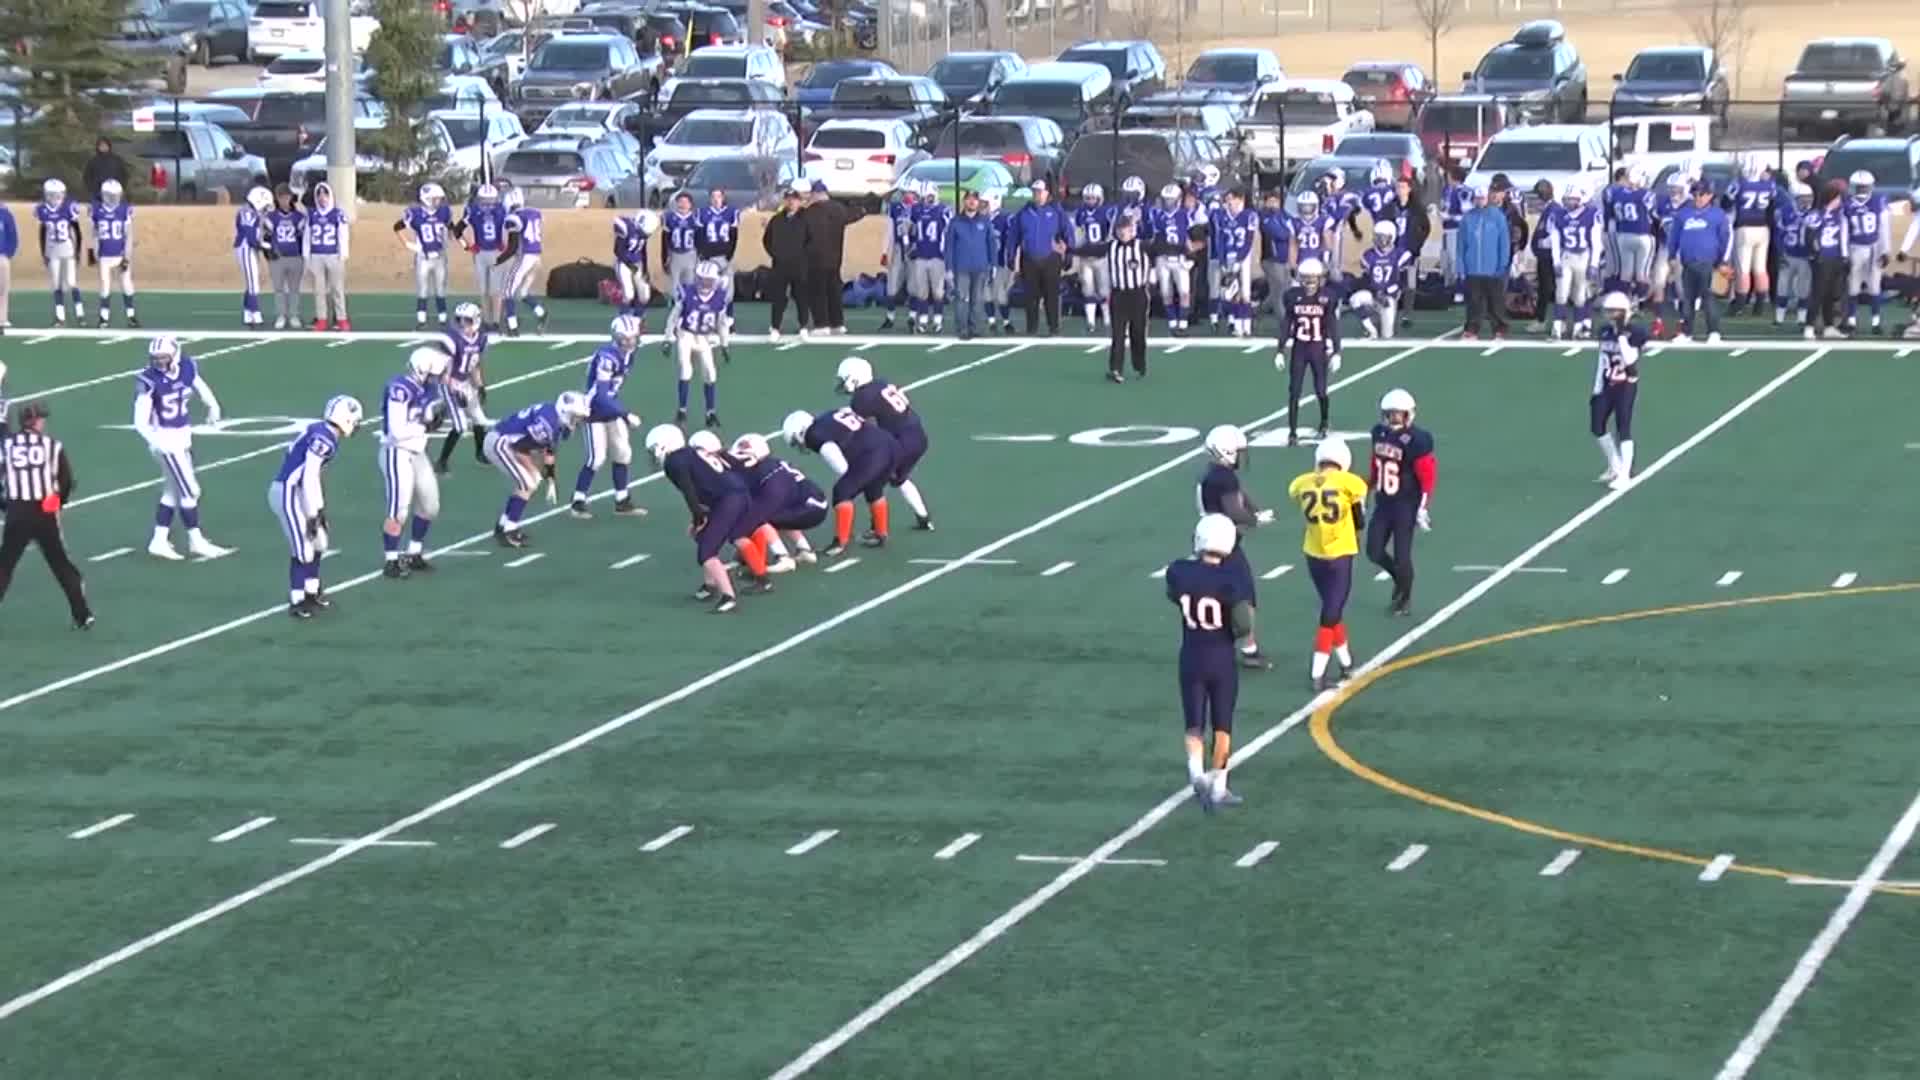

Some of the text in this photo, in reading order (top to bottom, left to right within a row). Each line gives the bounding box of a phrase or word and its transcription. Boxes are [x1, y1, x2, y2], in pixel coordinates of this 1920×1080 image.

[1743, 191, 1770, 209] 75
[311, 224, 337, 246] 22
[483, 222, 497, 240] 9
[706, 221, 730, 242] 44
[917, 220, 938, 242] 14
[1563, 227, 1587, 248] 51
[1296, 316, 1322, 341] 21
[12, 445, 45, 467] 50
[1302, 490, 1340, 525] 25
[1180, 594, 1224, 630] 10
